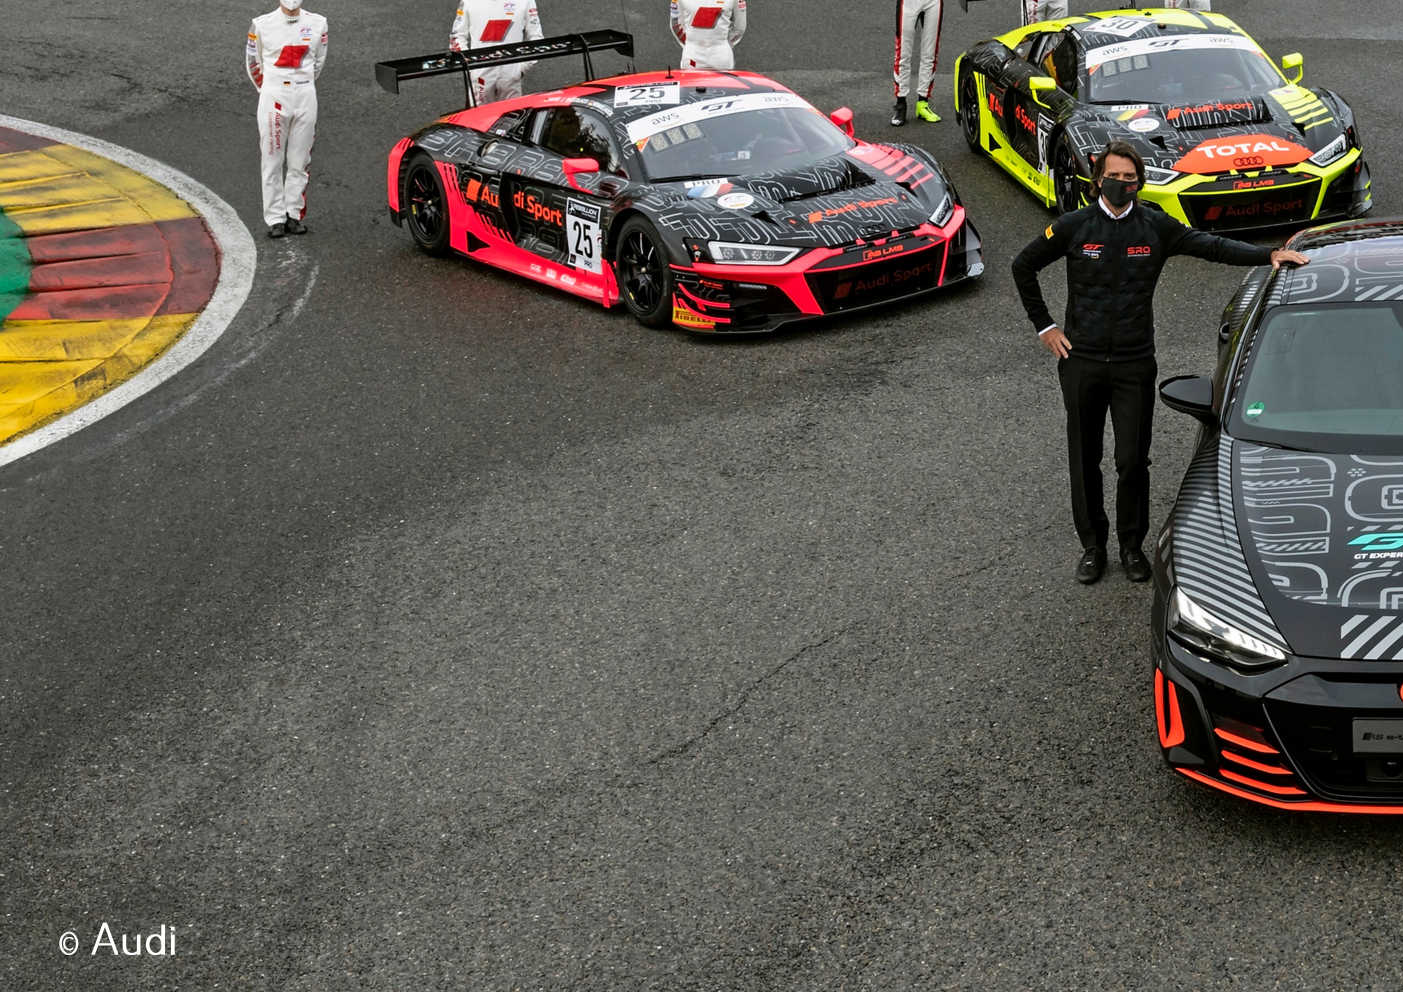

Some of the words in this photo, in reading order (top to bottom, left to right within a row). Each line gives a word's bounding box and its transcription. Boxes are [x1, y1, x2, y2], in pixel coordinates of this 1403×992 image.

[629, 87, 666, 100] 25
[1184, 104, 1214, 114] Audi
[1217, 102, 1253, 112] Sport
[1196, 141, 1290, 158] TOTAL
[527, 195, 563, 227] Sport
[825, 203, 858, 216] Audi
[858, 196, 898, 208] Sport
[1224, 202, 1261, 217] Audi
[1263, 198, 1304, 215] Sport
[573, 220, 593, 258] 25
[1128, 246, 1150, 254] SRO
[855, 272, 890, 292] Audi
[892, 262, 933, 287] Sport
